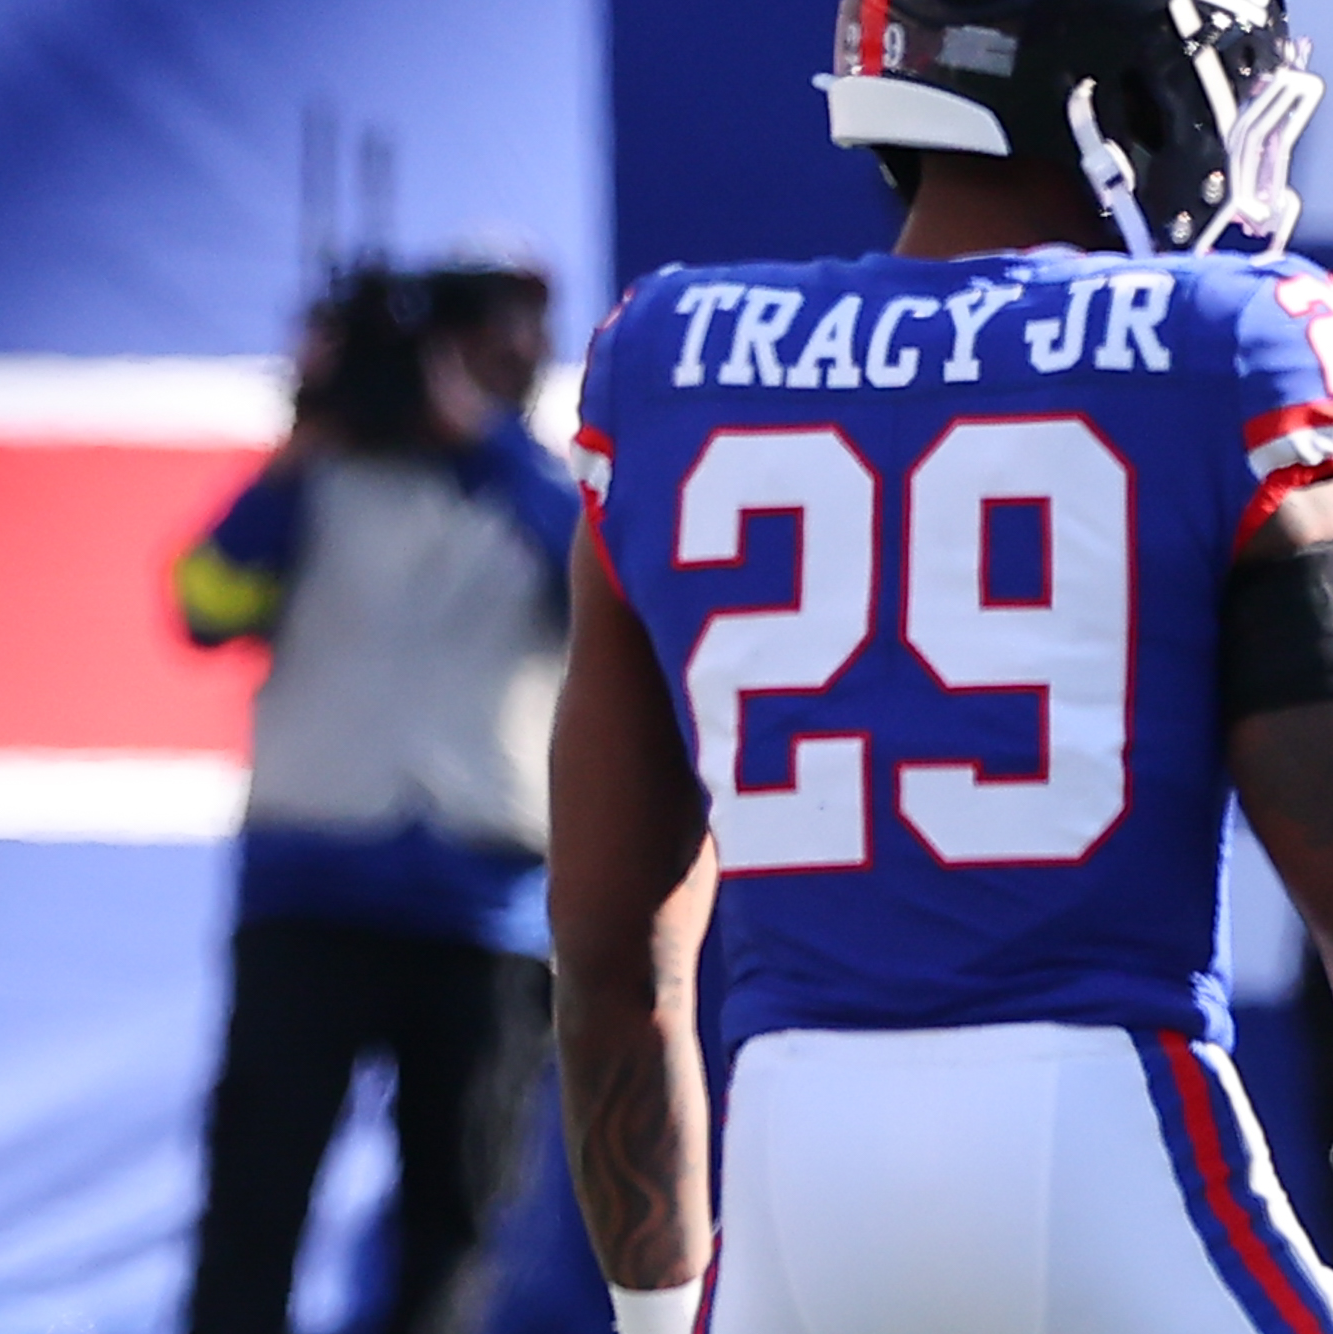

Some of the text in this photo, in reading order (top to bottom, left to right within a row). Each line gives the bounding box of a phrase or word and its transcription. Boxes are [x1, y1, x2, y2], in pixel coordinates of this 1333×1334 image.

[671, 282, 1024, 389] TRACY
[1025, 271, 1177, 373] JR
[671, 411, 1137, 879] 29
